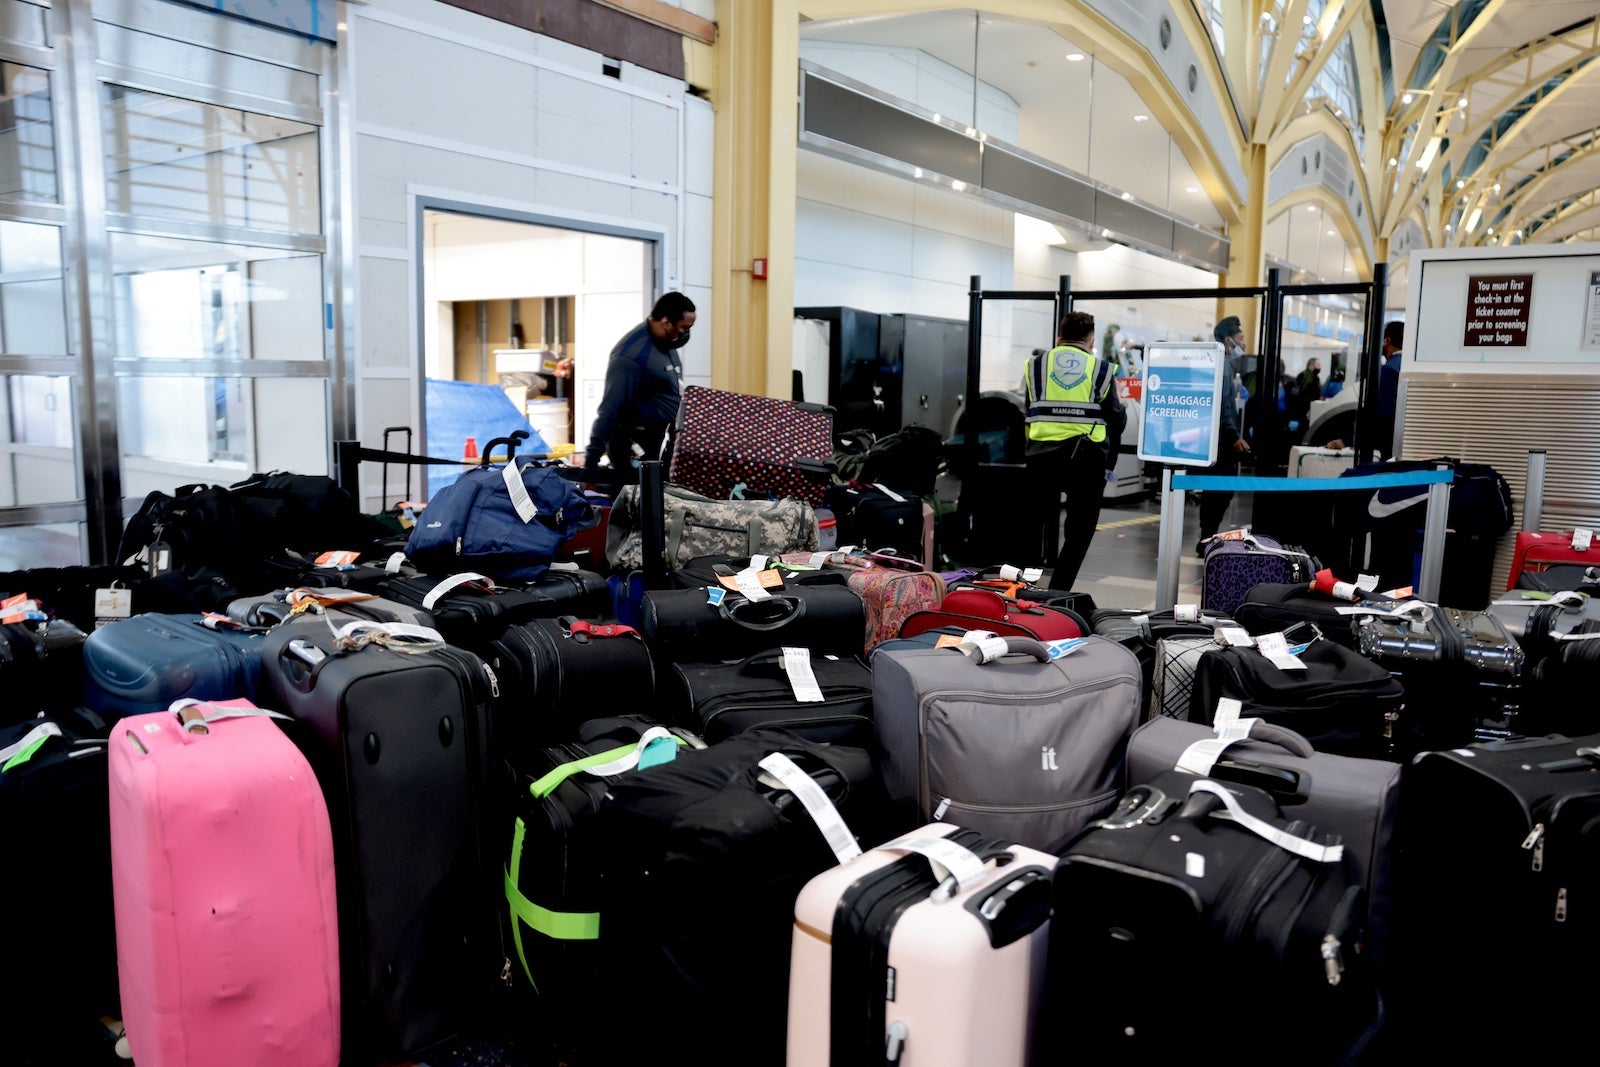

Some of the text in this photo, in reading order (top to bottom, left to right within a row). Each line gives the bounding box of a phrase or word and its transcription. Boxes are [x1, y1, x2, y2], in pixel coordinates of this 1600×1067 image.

[1478, 279, 1524, 290] You must first
[1474, 292, 1524, 304] check-in at the
[1476, 306, 1520, 316] ticket counter
[1468, 319, 1526, 332] prior to screening
[1478, 332, 1512, 344] your bags
[1150, 394, 1211, 406] TSA BAGGAGE
[1052, 408, 1085, 416] MANAGER
[1150, 408, 1198, 419] SCREENING
[1042, 746, 1058, 770] it
